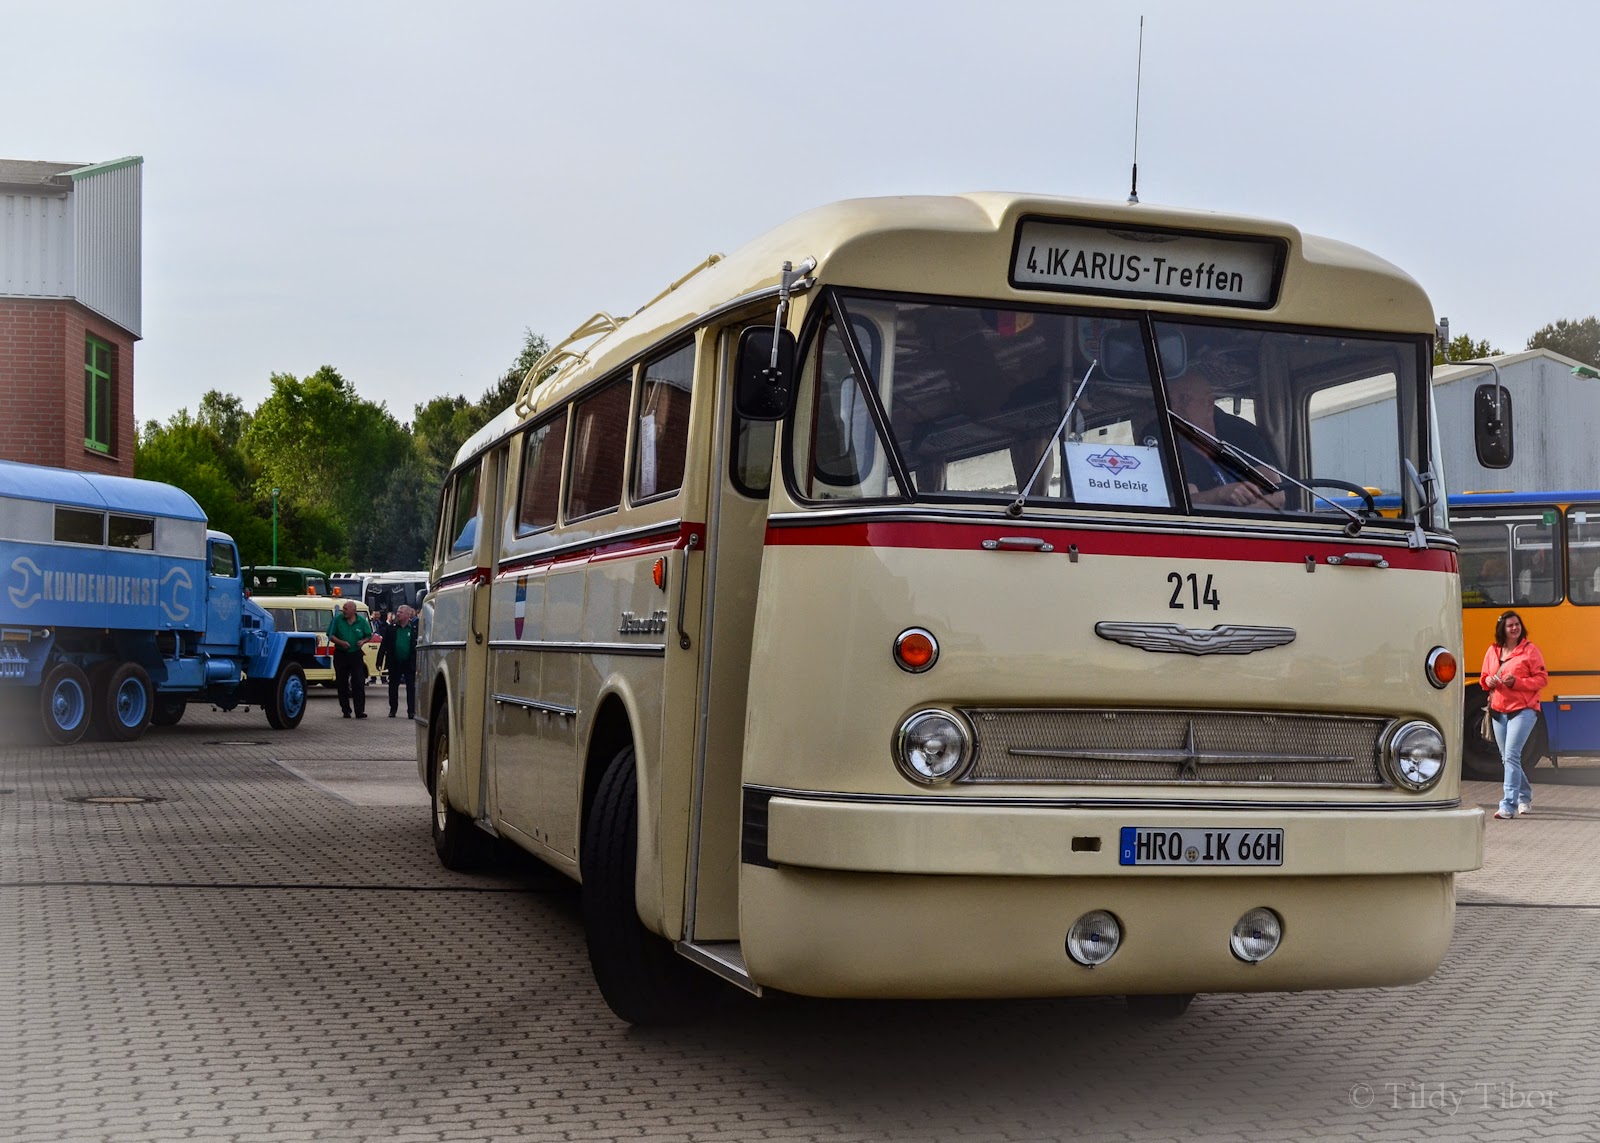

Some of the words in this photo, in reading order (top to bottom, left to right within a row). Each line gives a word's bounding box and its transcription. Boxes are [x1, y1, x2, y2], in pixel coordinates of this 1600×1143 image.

[1088, 478, 1111, 489] Bad
[1114, 480, 1148, 492] Belzig
[43, 570, 159, 606] KUNDENDIENST
[1167, 572, 1220, 611] 214
[1124, 849, 1131, 859] D
[1136, 832, 1183, 861] HRO
[1202, 833, 1231, 861] IK
[1238, 833, 1281, 861] 66H
